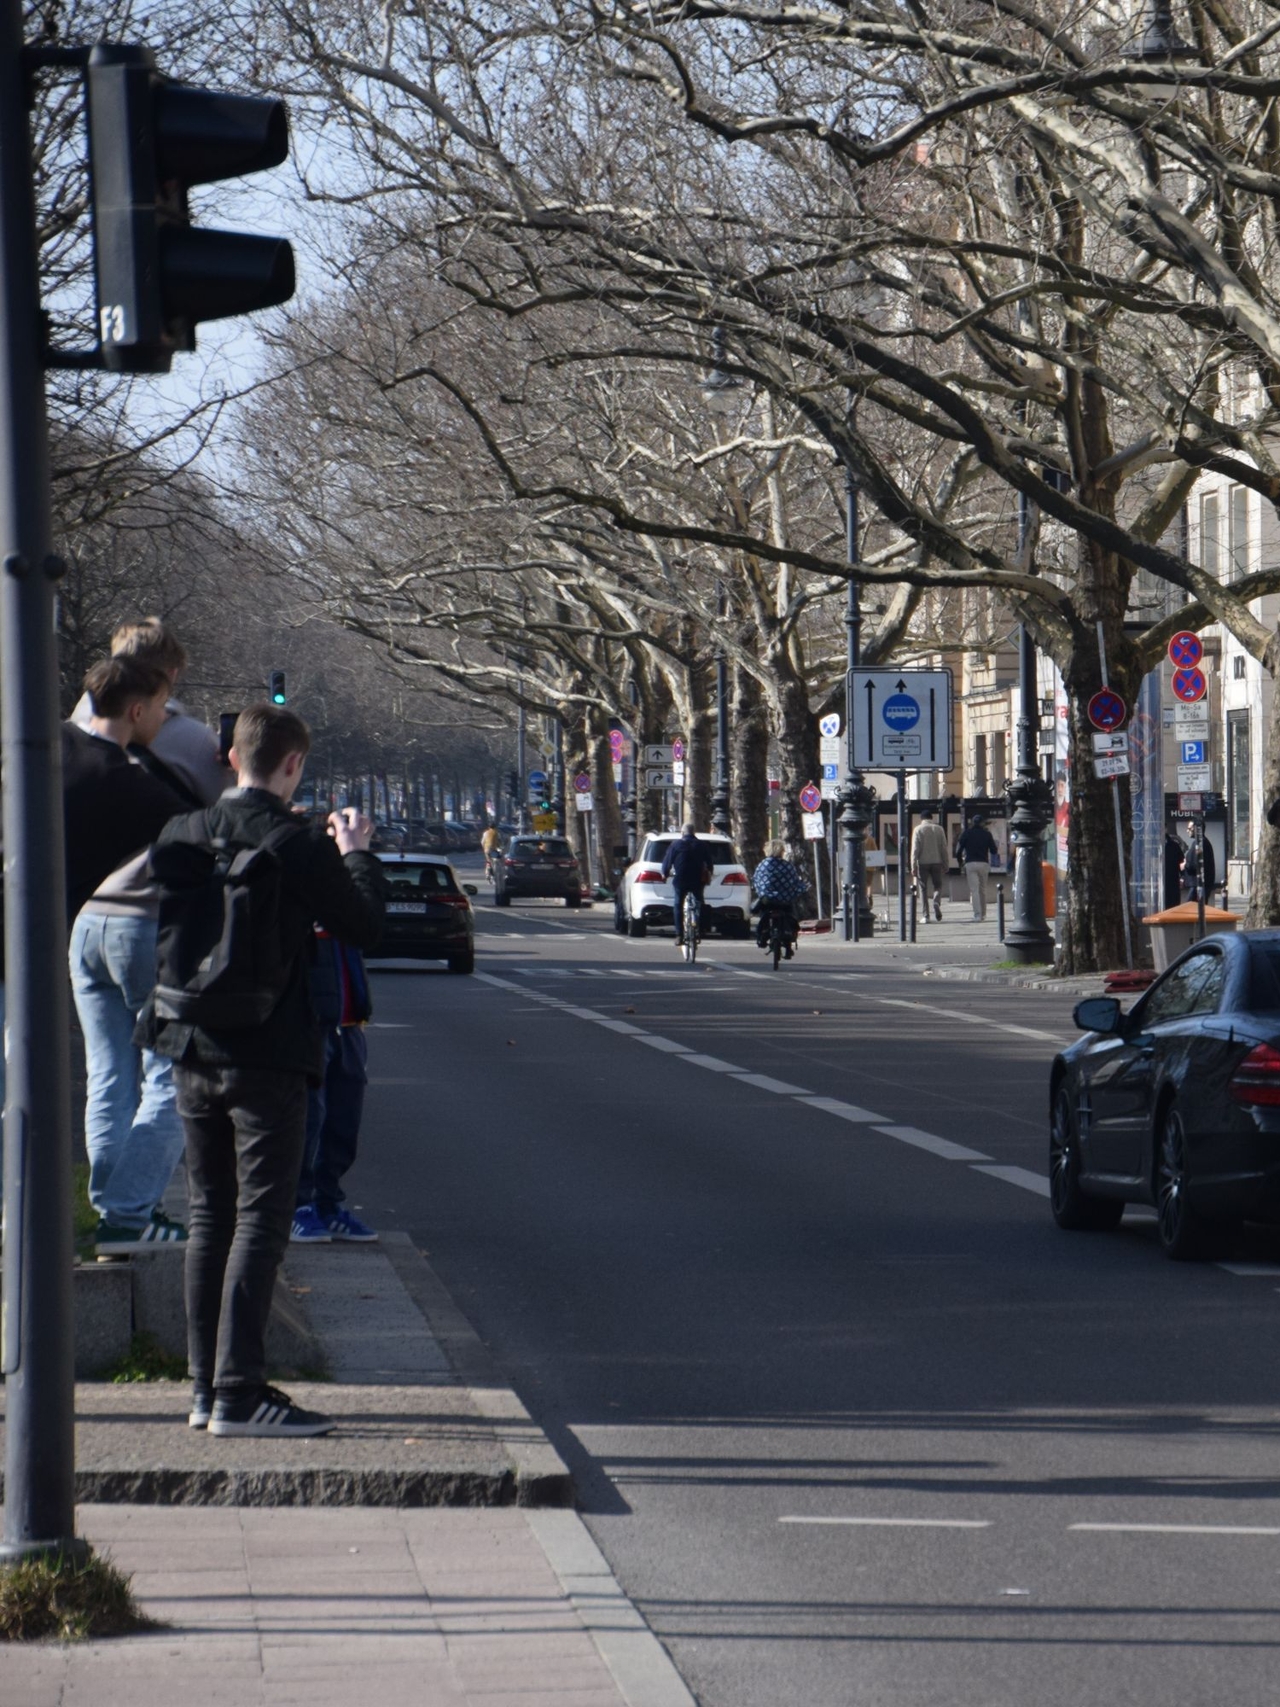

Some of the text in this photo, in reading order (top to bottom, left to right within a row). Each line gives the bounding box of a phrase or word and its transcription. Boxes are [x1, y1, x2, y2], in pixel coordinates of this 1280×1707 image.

[100, 304, 125, 342] F3
[1184, 743, 1197, 762] P
[1170, 808, 1207, 818] HUBLT
